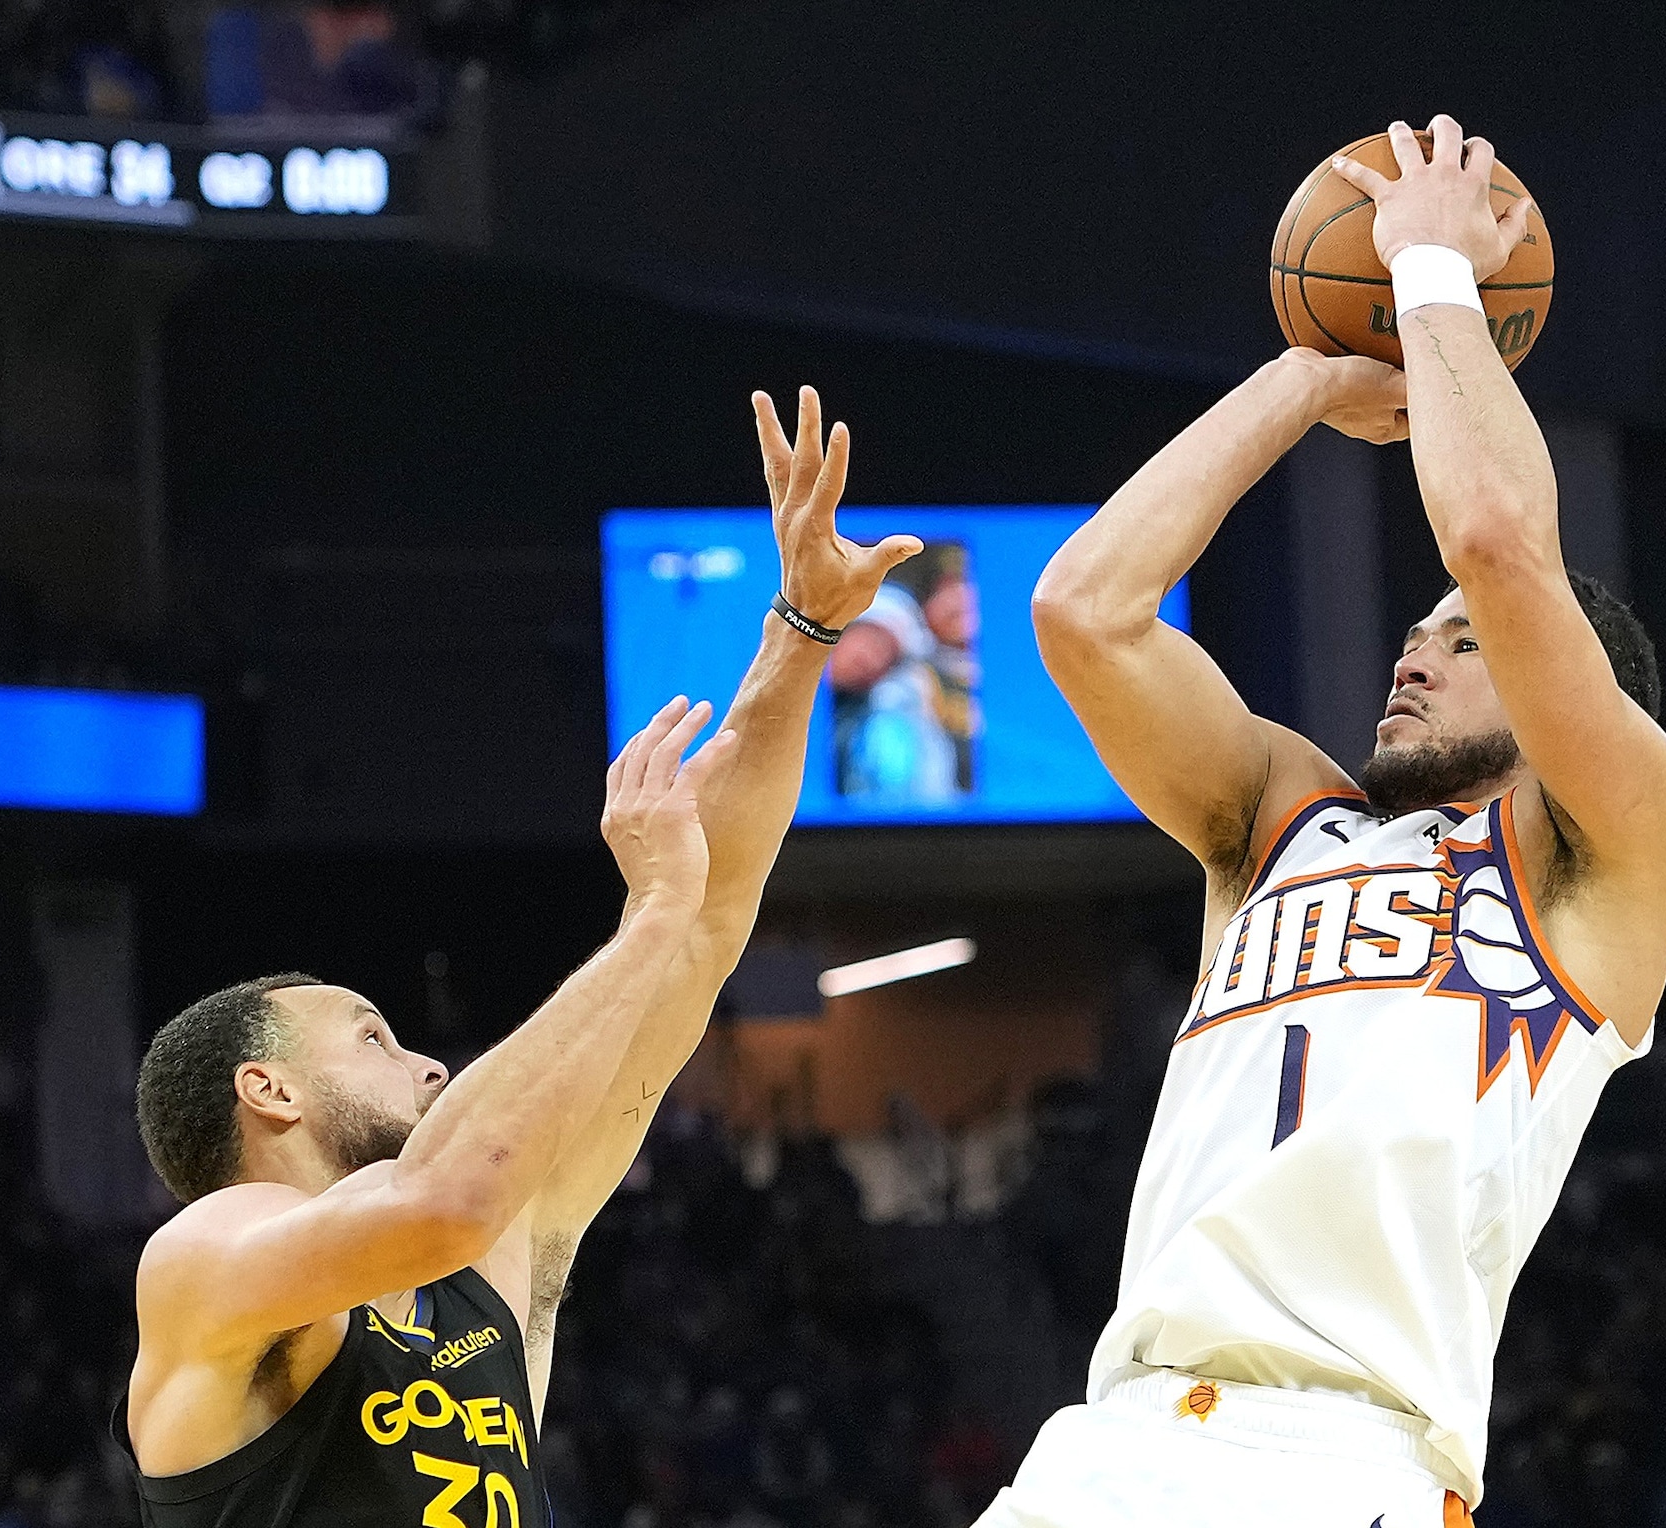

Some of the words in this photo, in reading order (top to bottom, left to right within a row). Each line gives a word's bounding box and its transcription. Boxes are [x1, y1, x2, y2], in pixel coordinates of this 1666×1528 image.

[784, 610, 815, 636] FAITH
[1199, 870, 1443, 1018] UNS
[1270, 1024, 1311, 1152] 1
[361, 1379, 529, 1470] GOEN
